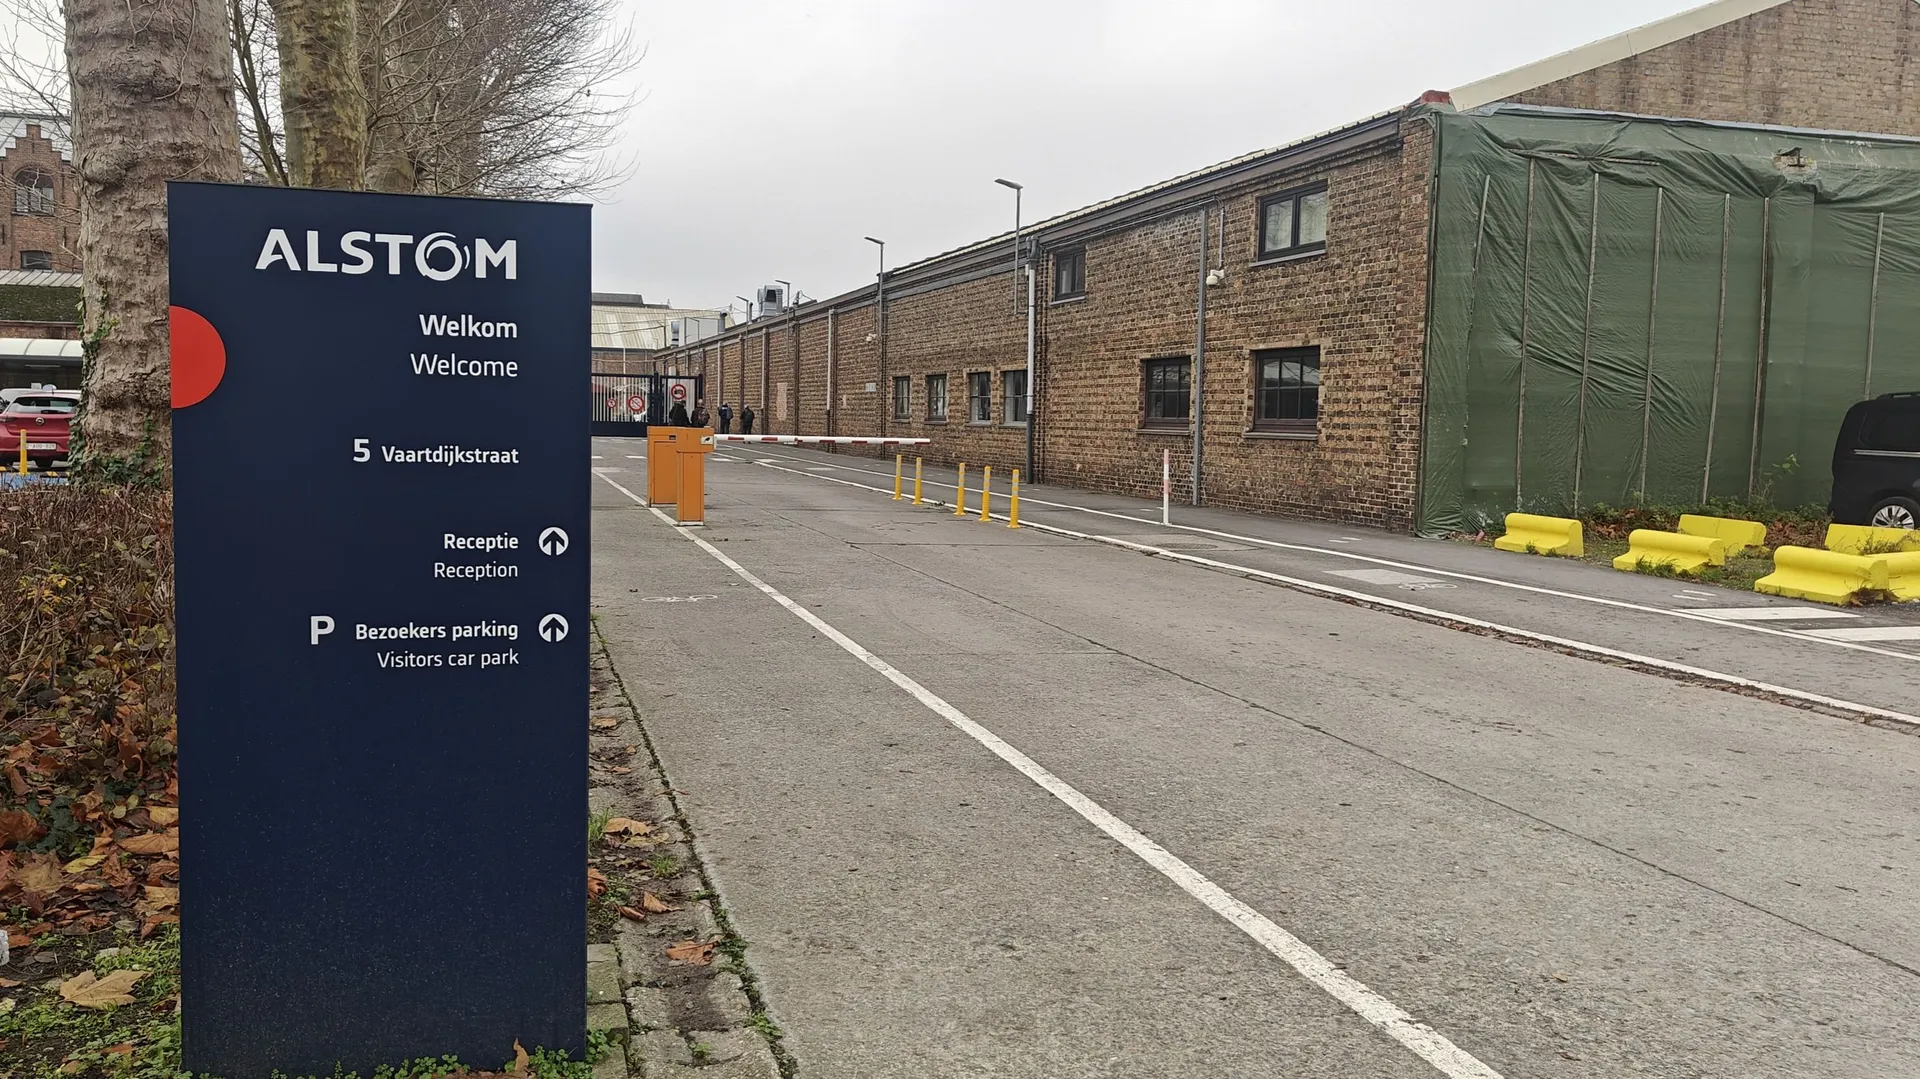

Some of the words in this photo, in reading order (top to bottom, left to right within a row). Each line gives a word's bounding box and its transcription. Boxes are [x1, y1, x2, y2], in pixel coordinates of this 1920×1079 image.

[255, 228, 518, 282] ALSTOM
[418, 313, 518, 339] Welkom
[409, 352, 519, 378] Welcome
[352, 438, 371, 463] 5
[381, 445, 520, 467] Vaartdijkstraat
[443, 531, 519, 553] Receptie
[433, 560, 519, 582] Reception
[310, 615, 335, 645] P
[355, 621, 447, 640] Bezoekers
[452, 619, 519, 642] parking
[376, 650, 443, 668] Visitors
[448, 653, 477, 668] car
[481, 647, 519, 669] park
